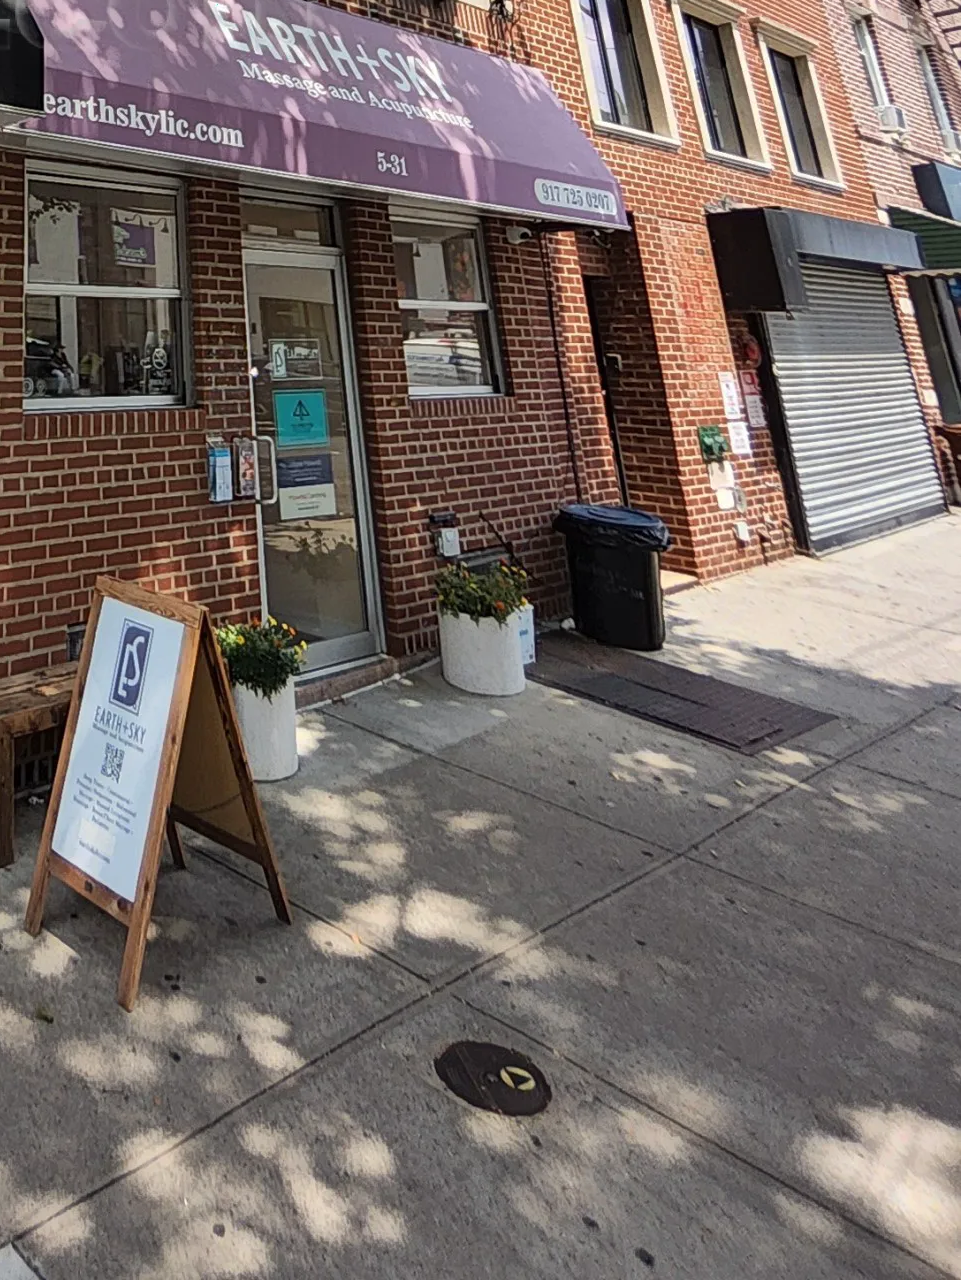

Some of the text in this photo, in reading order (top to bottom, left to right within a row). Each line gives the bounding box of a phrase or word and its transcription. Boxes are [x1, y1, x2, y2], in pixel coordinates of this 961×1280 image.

[207, 0, 454, 103] EARTH+SKY
[237, 59, 474, 128] Massage and Acupuncture
[43, 93, 245, 148] earthskylic.com
[377, 151, 409, 177] 5-31
[541, 183, 611, 211] 917 725 0207
[94, 705, 147, 745] EARTH+SKY
